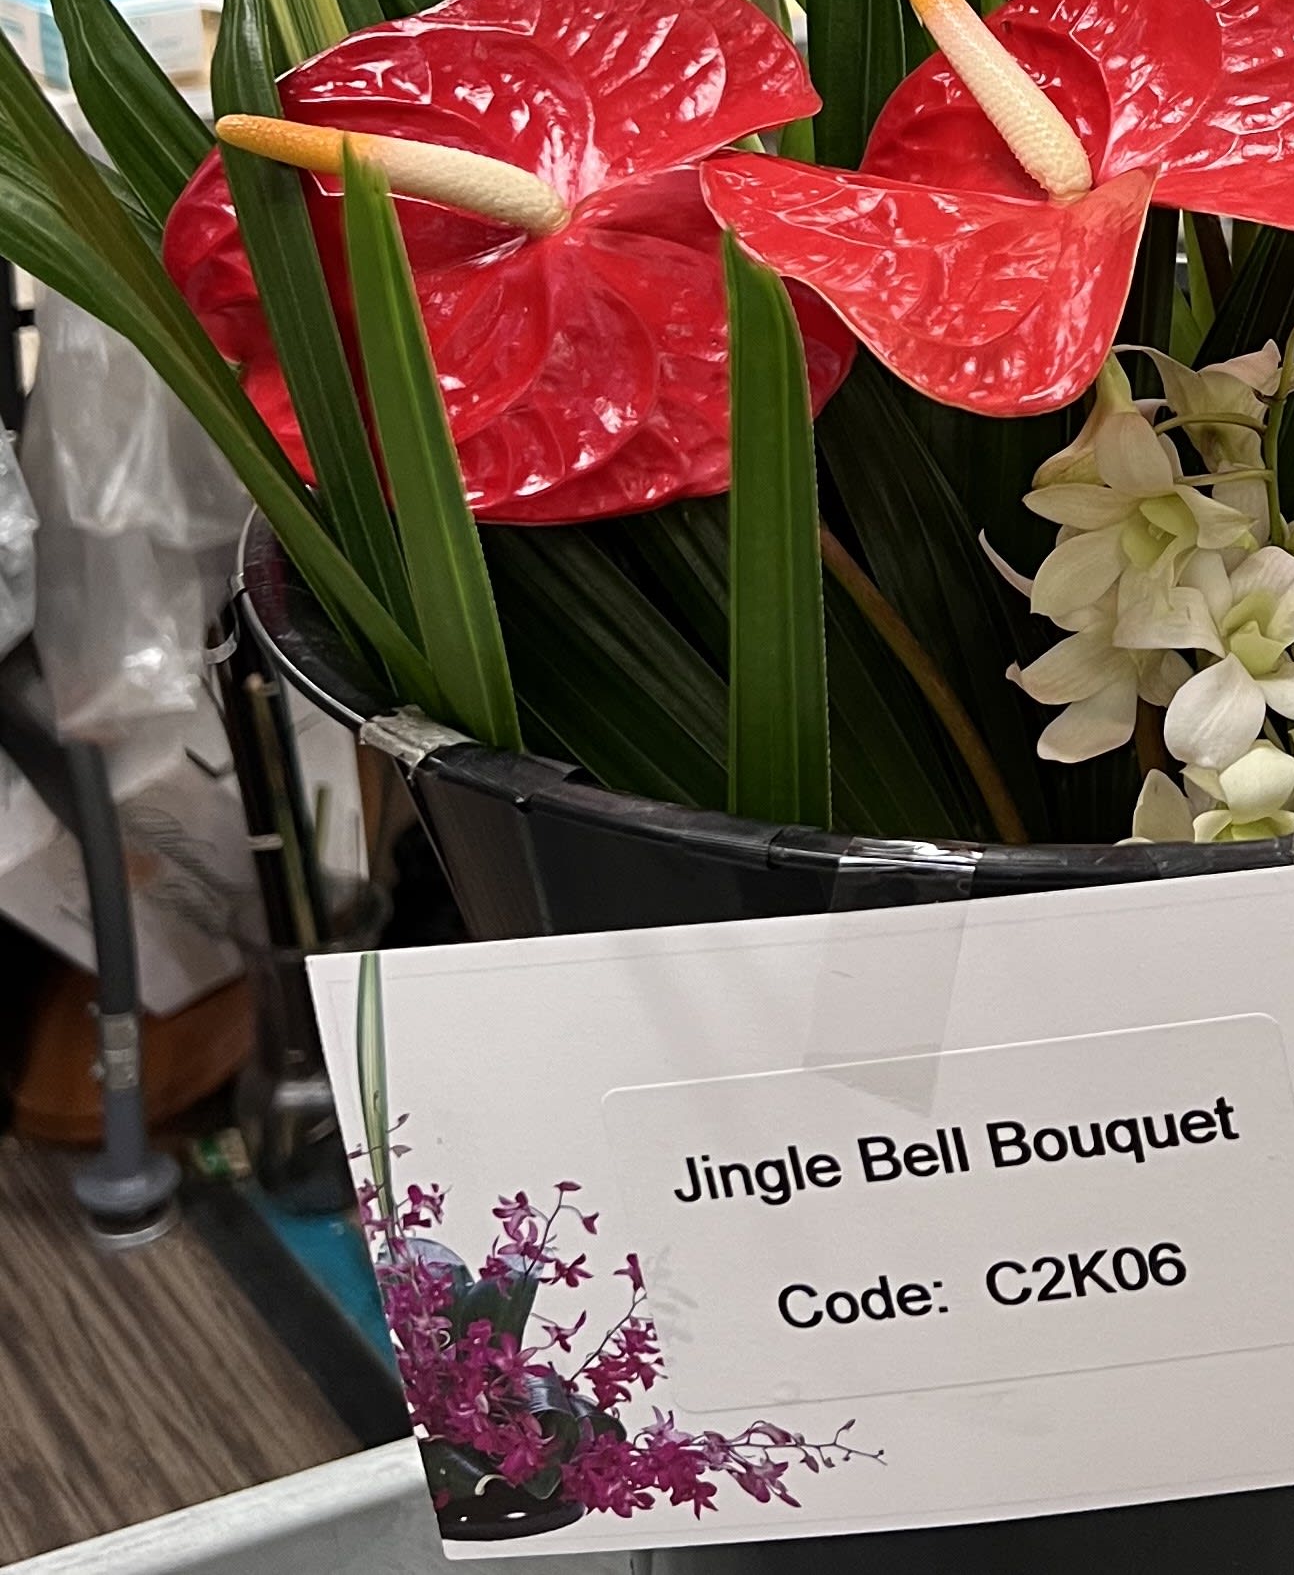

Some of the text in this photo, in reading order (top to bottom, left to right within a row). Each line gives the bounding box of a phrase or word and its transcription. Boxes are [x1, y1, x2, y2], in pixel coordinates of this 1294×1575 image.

[674, 1096, 1240, 1206] Jingle Bell Bouquet
[778, 1242, 1187, 1329] Code: C2K06
